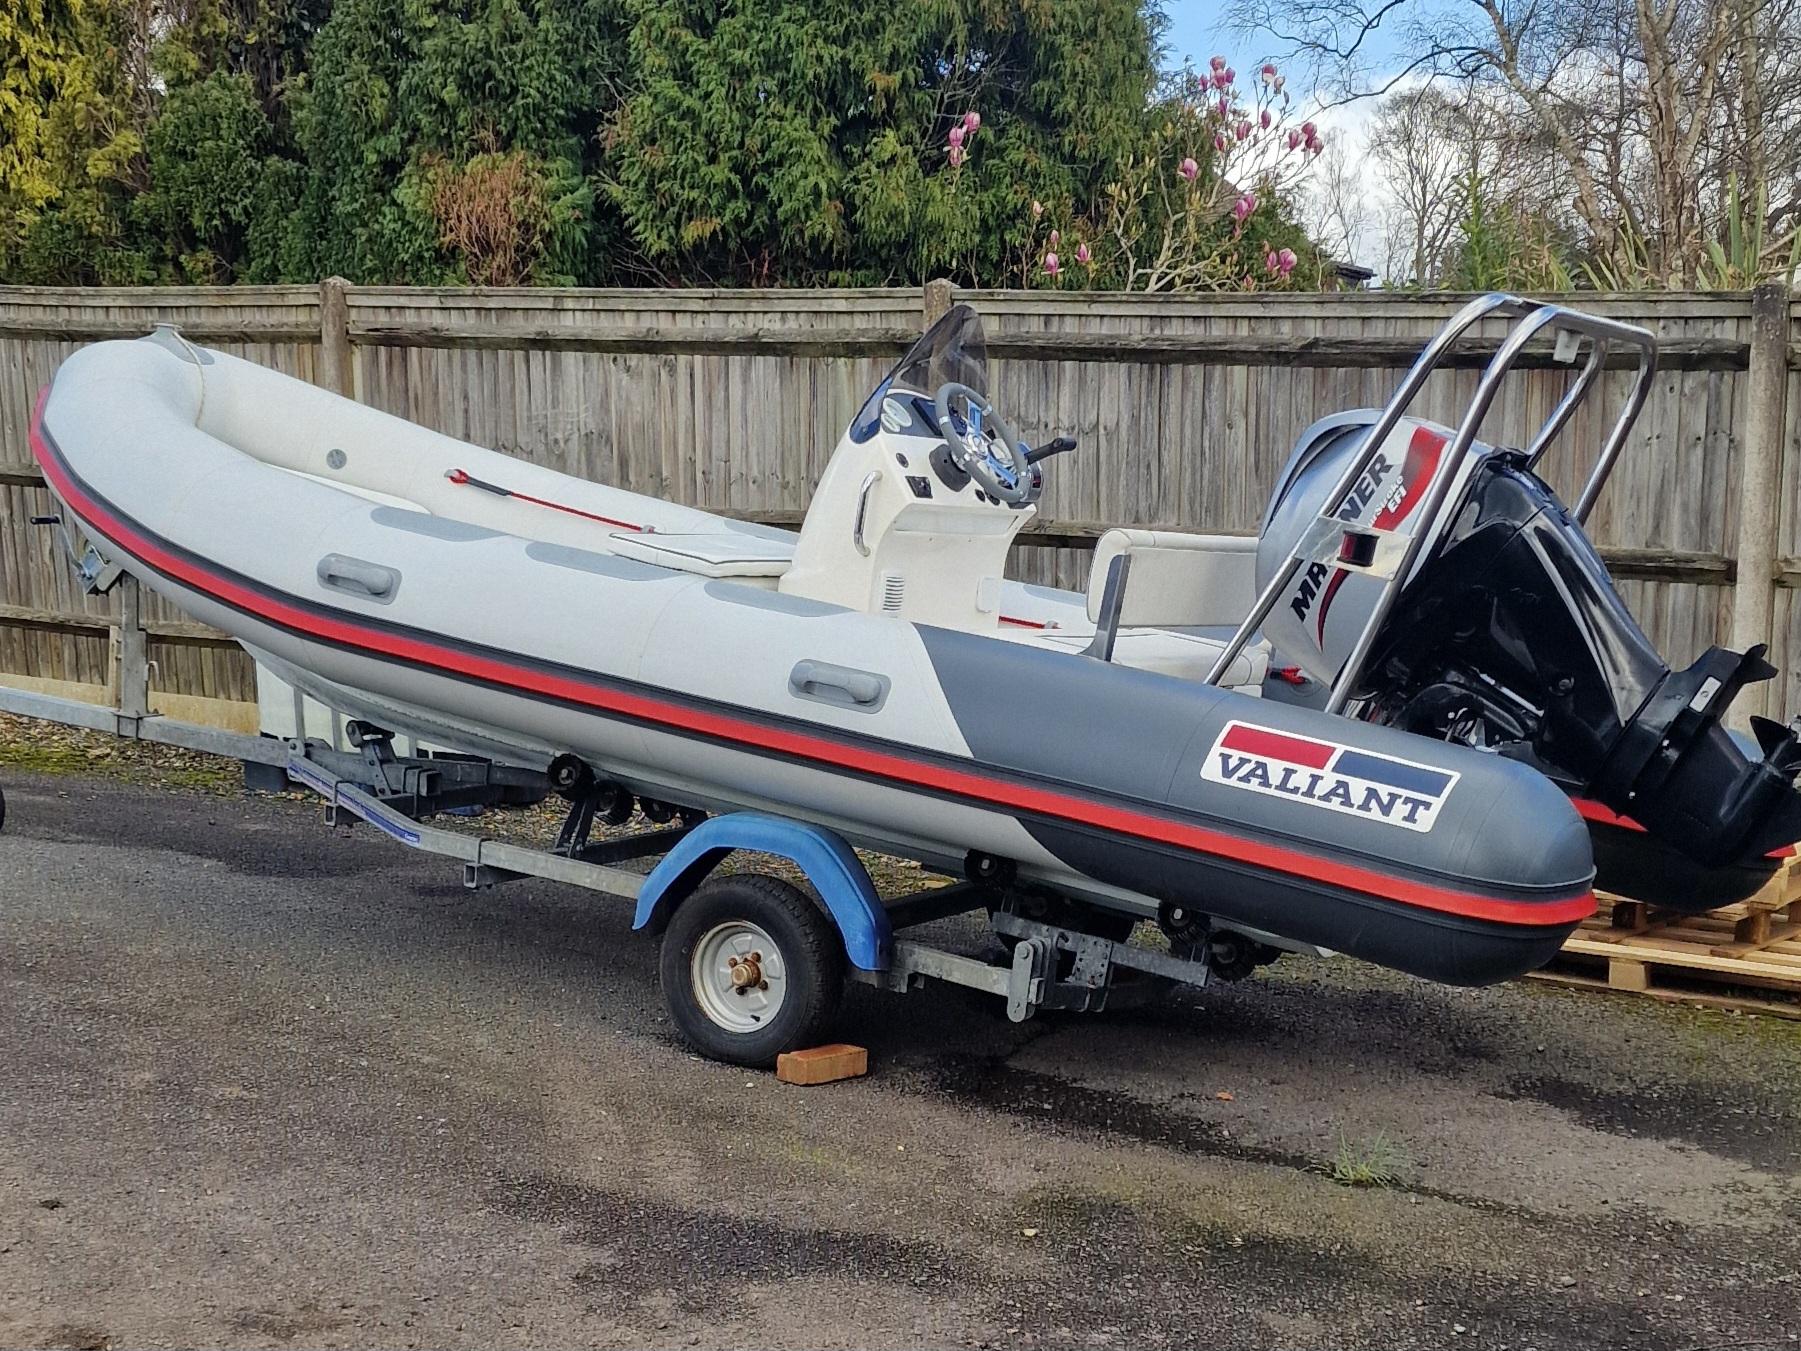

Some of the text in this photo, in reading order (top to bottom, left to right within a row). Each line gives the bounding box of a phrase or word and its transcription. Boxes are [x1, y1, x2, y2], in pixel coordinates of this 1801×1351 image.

[1387, 484, 1407, 514] EFI
[1290, 453, 1394, 623] MANER
[1218, 752, 1433, 824] VALIANT
